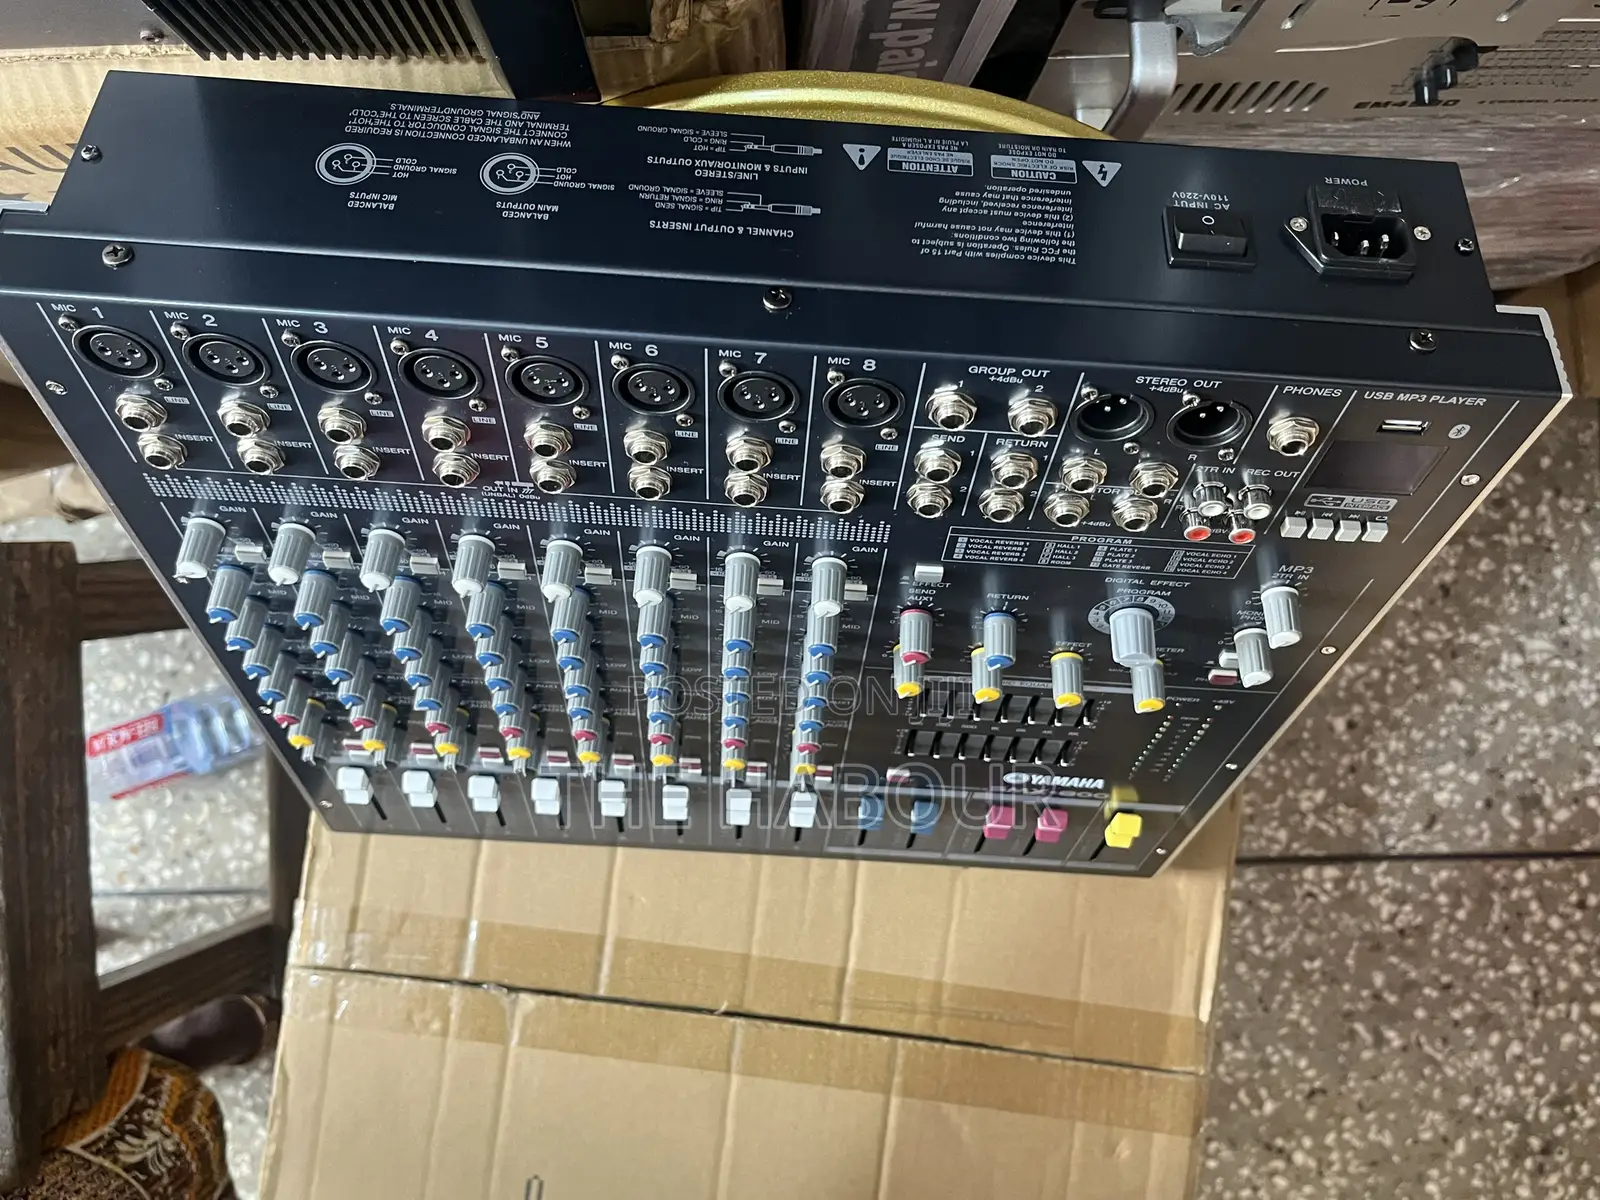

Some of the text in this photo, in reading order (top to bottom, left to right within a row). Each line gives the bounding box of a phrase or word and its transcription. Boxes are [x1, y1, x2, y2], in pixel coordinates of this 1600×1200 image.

[413, 113, 451, 122] SCREEN
[453, 116, 482, 124] CABLE
[408, 121, 466, 131] CONDUCTOR
[468, 125, 501, 134] SIGNAL
[526, 121, 569, 130] TERMINAL
[344, 126, 392, 135] REQUIRED
[404, 130, 465, 140] CONNECTION
[523, 128, 567, 138] CONNECT
[466, 134, 528, 144] UNBALANCED
[544, 139, 571, 147] WHEN
[647, 156, 692, 166] OUTPUTS
[695, 159, 762, 171] MONITOR/AUX
[394, 164, 426, 173] GROUND
[773, 165, 808, 174] INPUTS
[902, 161, 958, 174] ATTENTION
[695, 169, 758, 180] LINE/STEREO
[1011, 170, 1057, 180] CAUTION
[1325, 176, 1368, 186] POWER
[954, 191, 980, 199] cause
[984, 185, 1071, 196] undesired operation.
[349, 191, 398, 201] MIC INPUTS
[1021, 195, 1071, 204] interference
[1172, 191, 1229, 202] 110V-220V
[347, 200, 395, 210] BALANCED
[496, 201, 536, 211] OUTPUTS
[938, 197, 1072, 213] interference received, including
[1173, 200, 1210, 210] INPUT
[502, 211, 549, 220] BALANCED
[959, 208, 988, 216] accept
[1013, 211, 1041, 219] device
[649, 220, 692, 231] INSERTS
[694, 223, 735, 234] OUTPUT
[914, 221, 948, 230] harmful
[950, 224, 975, 232] cause
[1022, 220, 1074, 229] interference
[746, 226, 794, 238] CHANNEL
[1014, 228, 1042, 236] device
[951, 233, 999, 242] conditions:
[1019, 237, 1059, 246] following
[922, 239, 953, 247] subject
[966, 242, 1009, 251] Operation
[1012, 245, 1038, 253] Rules.
[985, 252, 1024, 261] complies
[1027, 254, 1055, 263] device
[51, 303, 104, 319] MIC 1
[164, 311, 218, 327] MIC 2
[277, 318, 329, 334] MIC 3
[387, 326, 439, 342] MIC 4
[498, 333, 549, 349] MIC 5
[609, 341, 659, 357] MIC 6
[718, 350, 767, 364] MIC 7
[828, 357, 876, 371] MIC 8
[968, 366, 1050, 378] GROUP OUT
[989, 375, 1023, 384] +4dBu
[1135, 376, 1223, 388] STEREO OUT
[1282, 386, 1343, 397] PHONES
[1364, 392, 1487, 407] USB MP3 PLAYER
[175, 433, 214, 443] INSERT
[931, 434, 965, 443] SEND
[274, 440, 312, 449] INSERT
[996, 438, 1049, 448] RETURN
[372, 447, 411, 455] INSERT
[471, 453, 509, 462] INSERT
[568, 459, 608, 468] INSERT
[666, 466, 704, 475] INSERT
[763, 472, 801, 481] INSERT
[859, 479, 897, 487] INSERT
[219, 505, 247, 514] GAIN
[310, 511, 338, 520] GAIN
[401, 517, 429, 525] GAIN
[493, 522, 521, 531] GAIN
[673, 534, 700, 542] GAIN
[1071, 536, 1132, 545] PROGRAM
[1279, 565, 1314, 574] MP3
[1116, 588, 1171, 596] PROGRAM
[1031, 774, 1105, 789] YAMAHA
